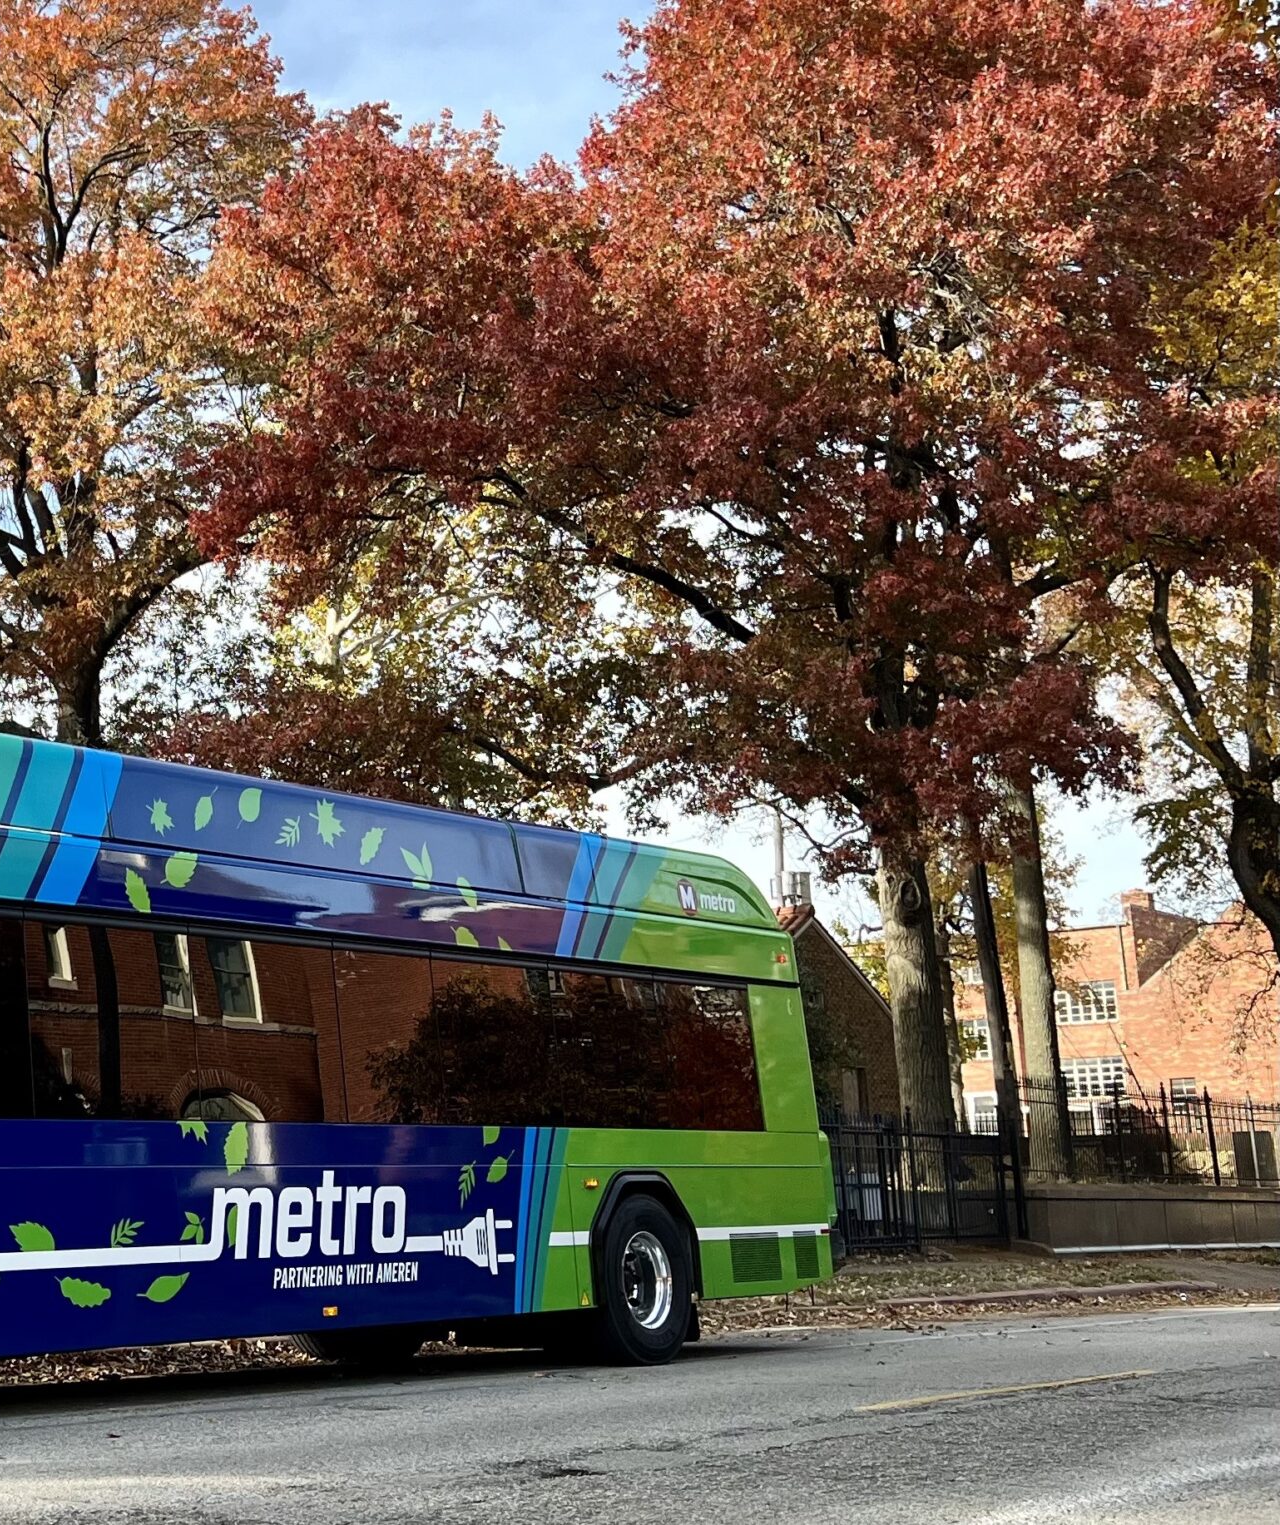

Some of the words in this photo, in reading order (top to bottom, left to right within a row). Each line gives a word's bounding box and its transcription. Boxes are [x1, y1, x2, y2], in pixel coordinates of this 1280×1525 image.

[700, 893, 736, 913] metro
[207, 1169, 407, 1260] metro
[273, 1265, 343, 1290] PARTNERING
[346, 1264, 373, 1286] WITH
[376, 1260, 419, 1284] AMEREN
